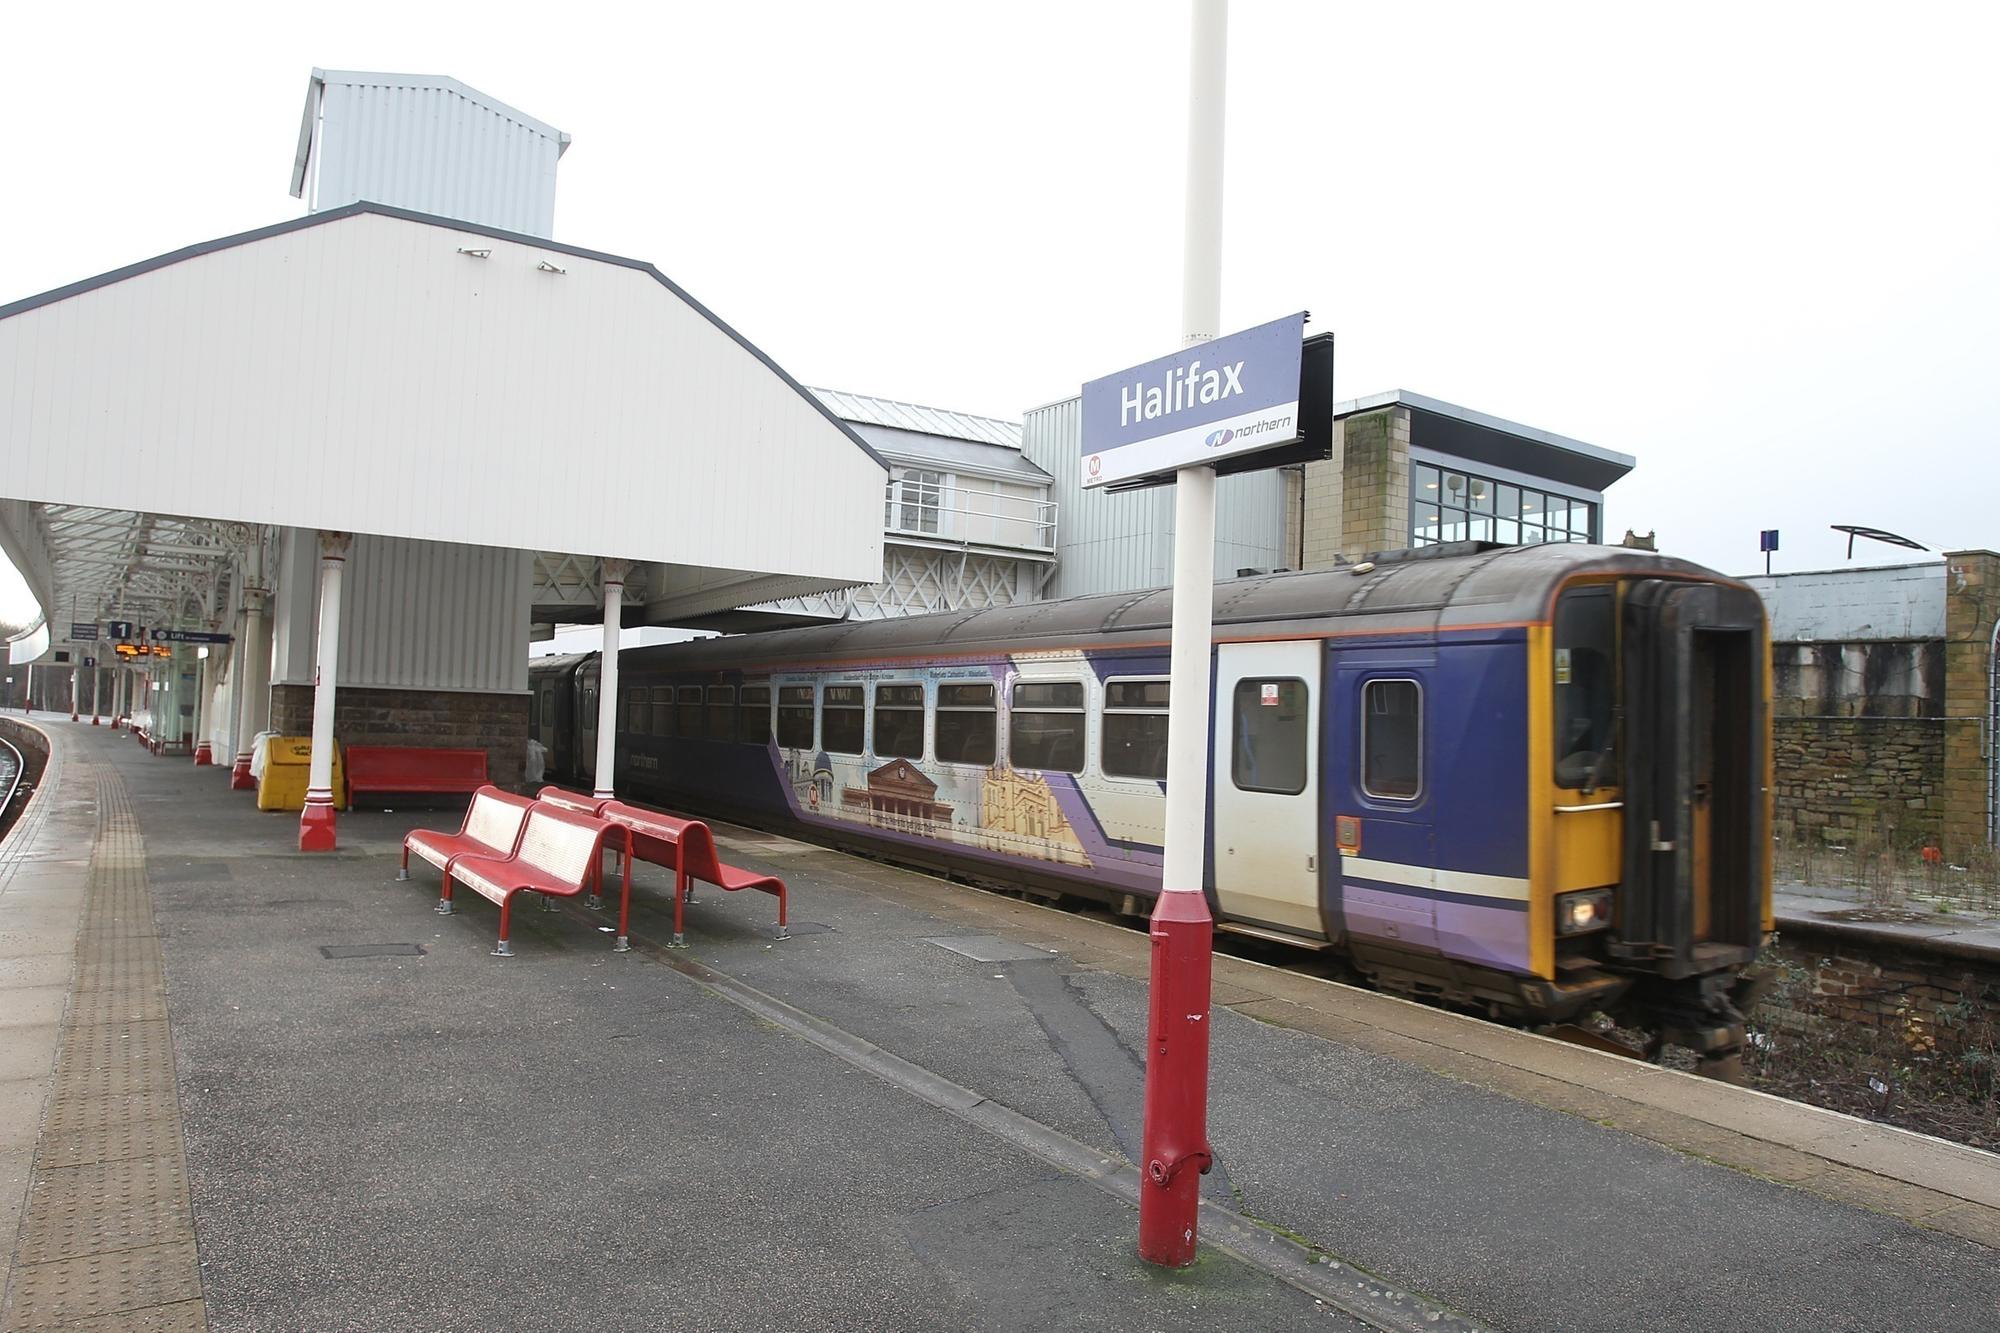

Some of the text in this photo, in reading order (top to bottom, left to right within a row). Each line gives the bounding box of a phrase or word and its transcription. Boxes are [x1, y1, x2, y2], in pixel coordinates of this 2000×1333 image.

[1121, 361, 1244, 427] Halifax
[1235, 416, 1291, 439] northern
[118, 623, 127, 638] 1
[171, 632, 185, 640] Lift
